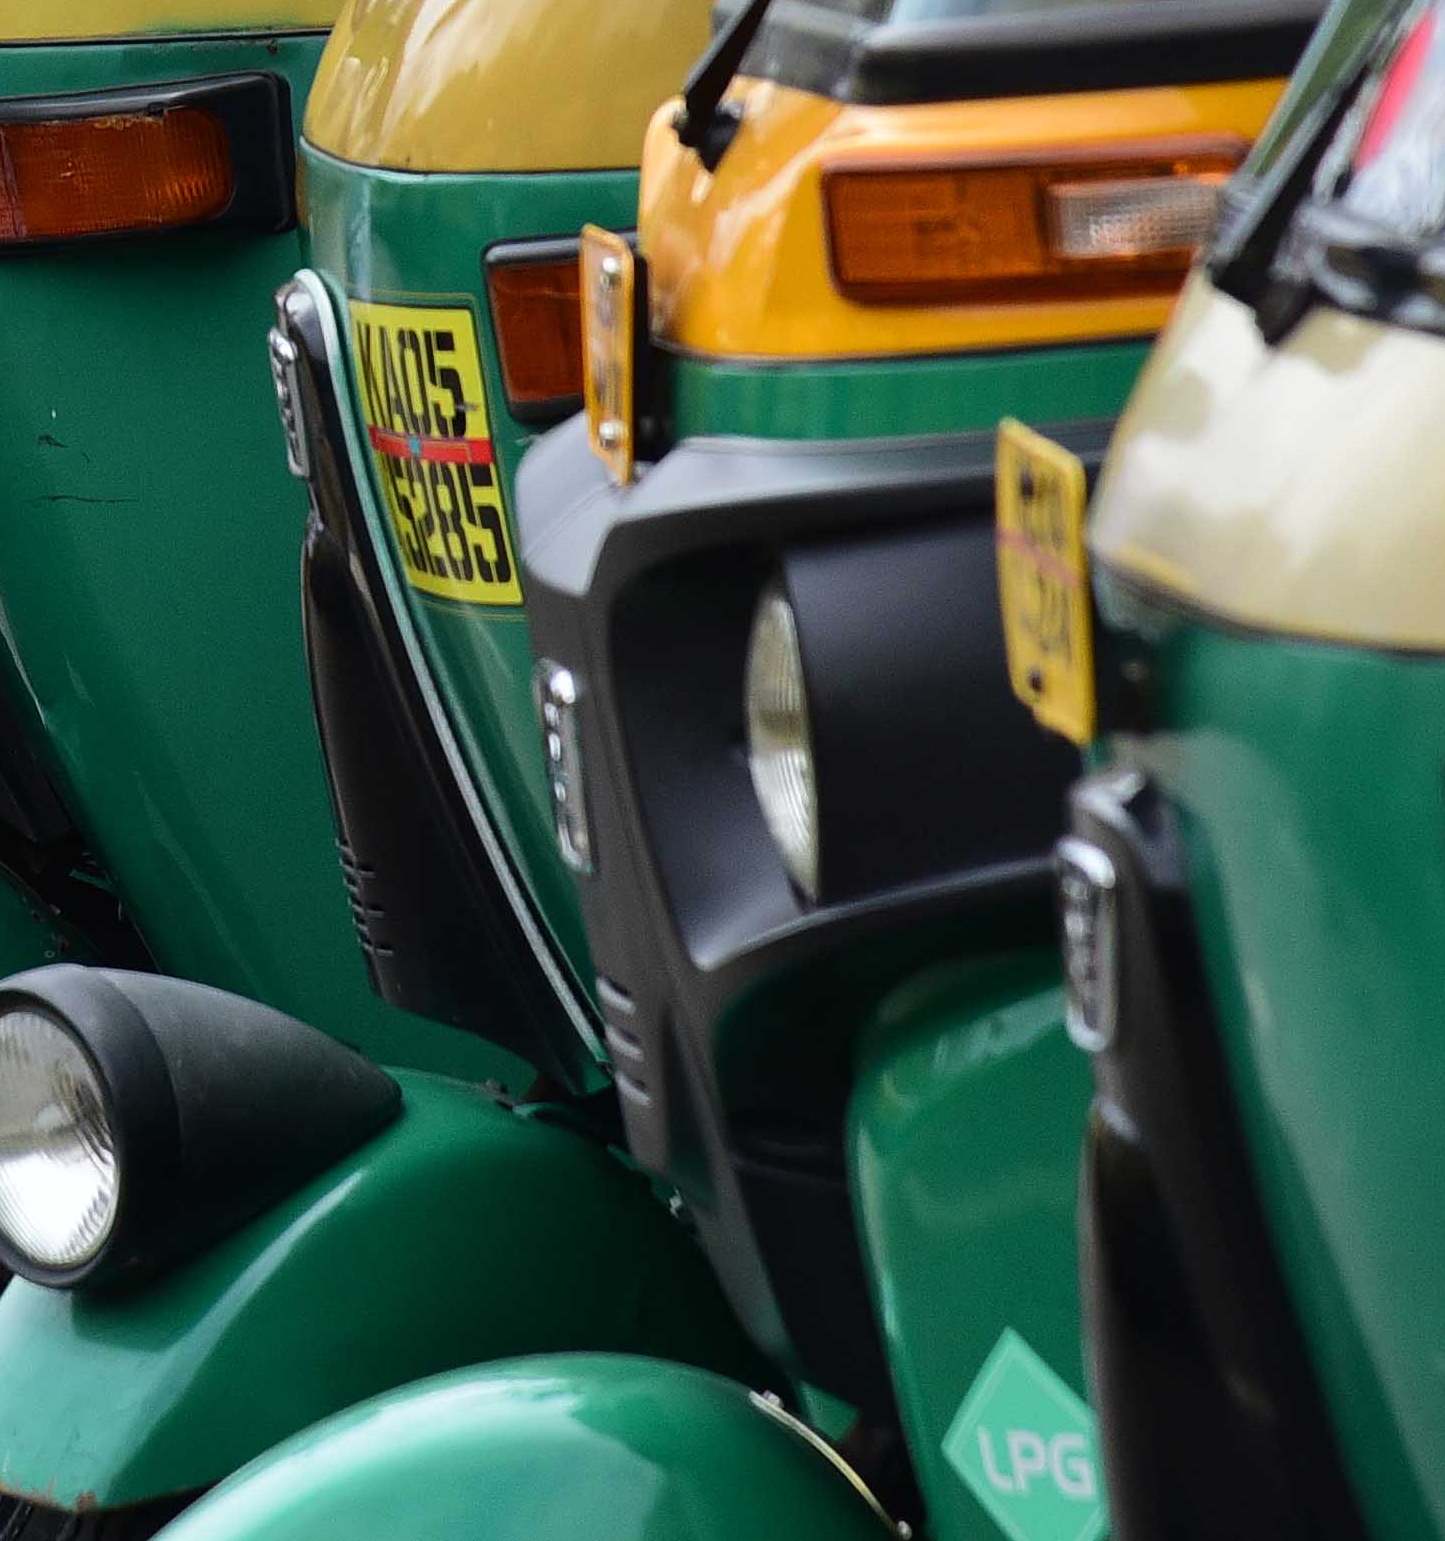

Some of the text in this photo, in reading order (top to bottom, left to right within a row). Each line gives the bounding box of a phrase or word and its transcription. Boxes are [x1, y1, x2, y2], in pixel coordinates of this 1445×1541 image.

[356, 321, 467, 438] KA05
[383, 454, 511, 583] 5285
[977, 1426, 1097, 1499] LPG
